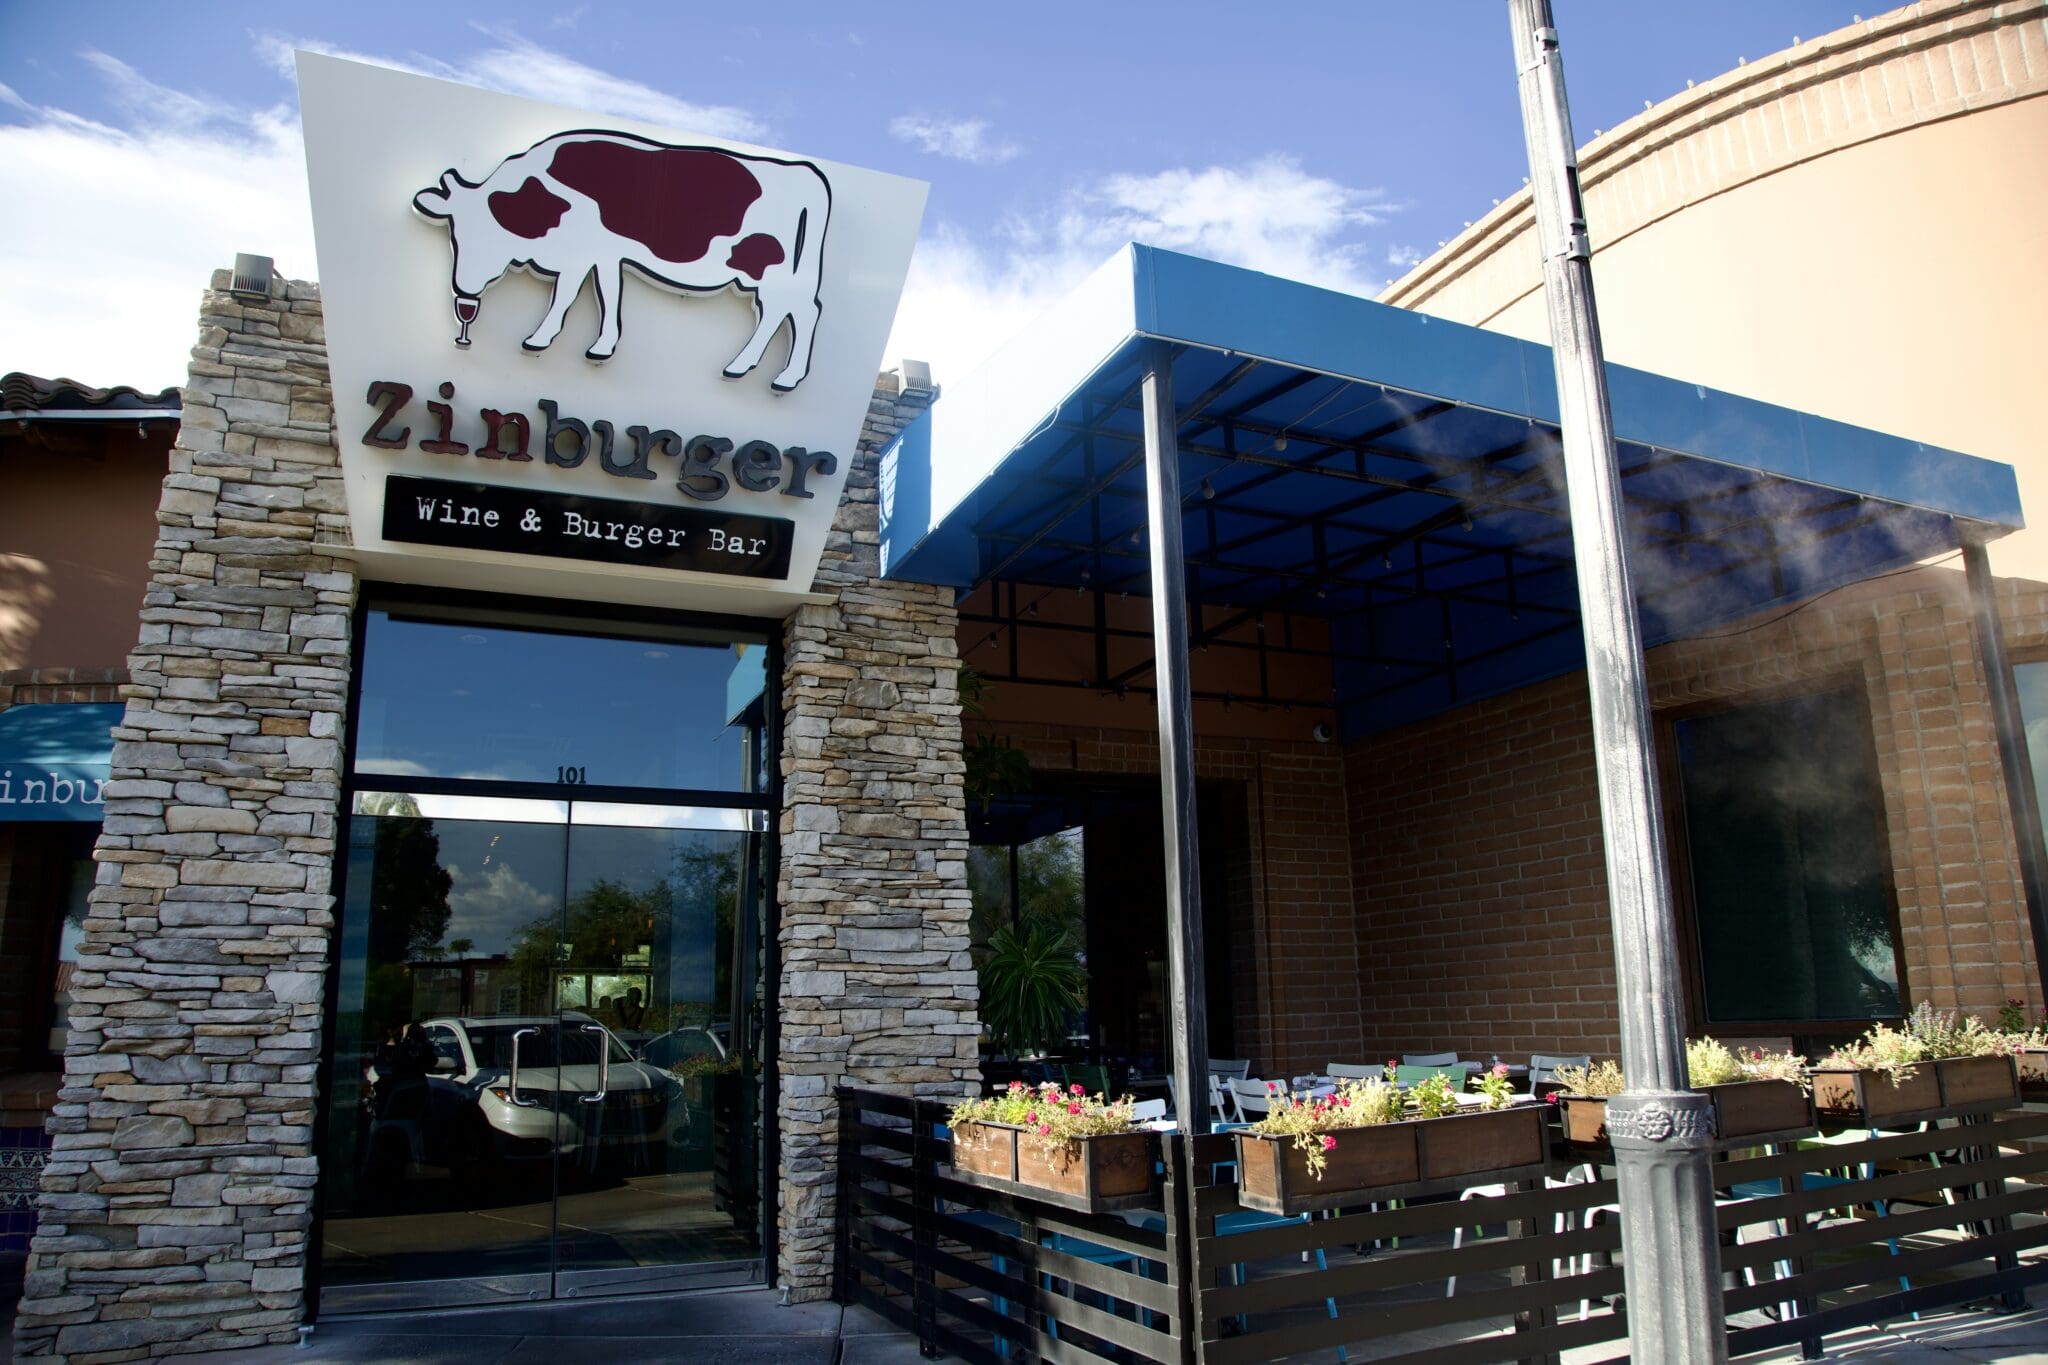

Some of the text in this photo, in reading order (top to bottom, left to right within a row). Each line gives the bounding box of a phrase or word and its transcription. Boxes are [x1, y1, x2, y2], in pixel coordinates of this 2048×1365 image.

[362, 380, 838, 501] Zinburger
[415, 497, 769, 556] Wine & Burger Bar
[556, 765, 587, 785] 101
